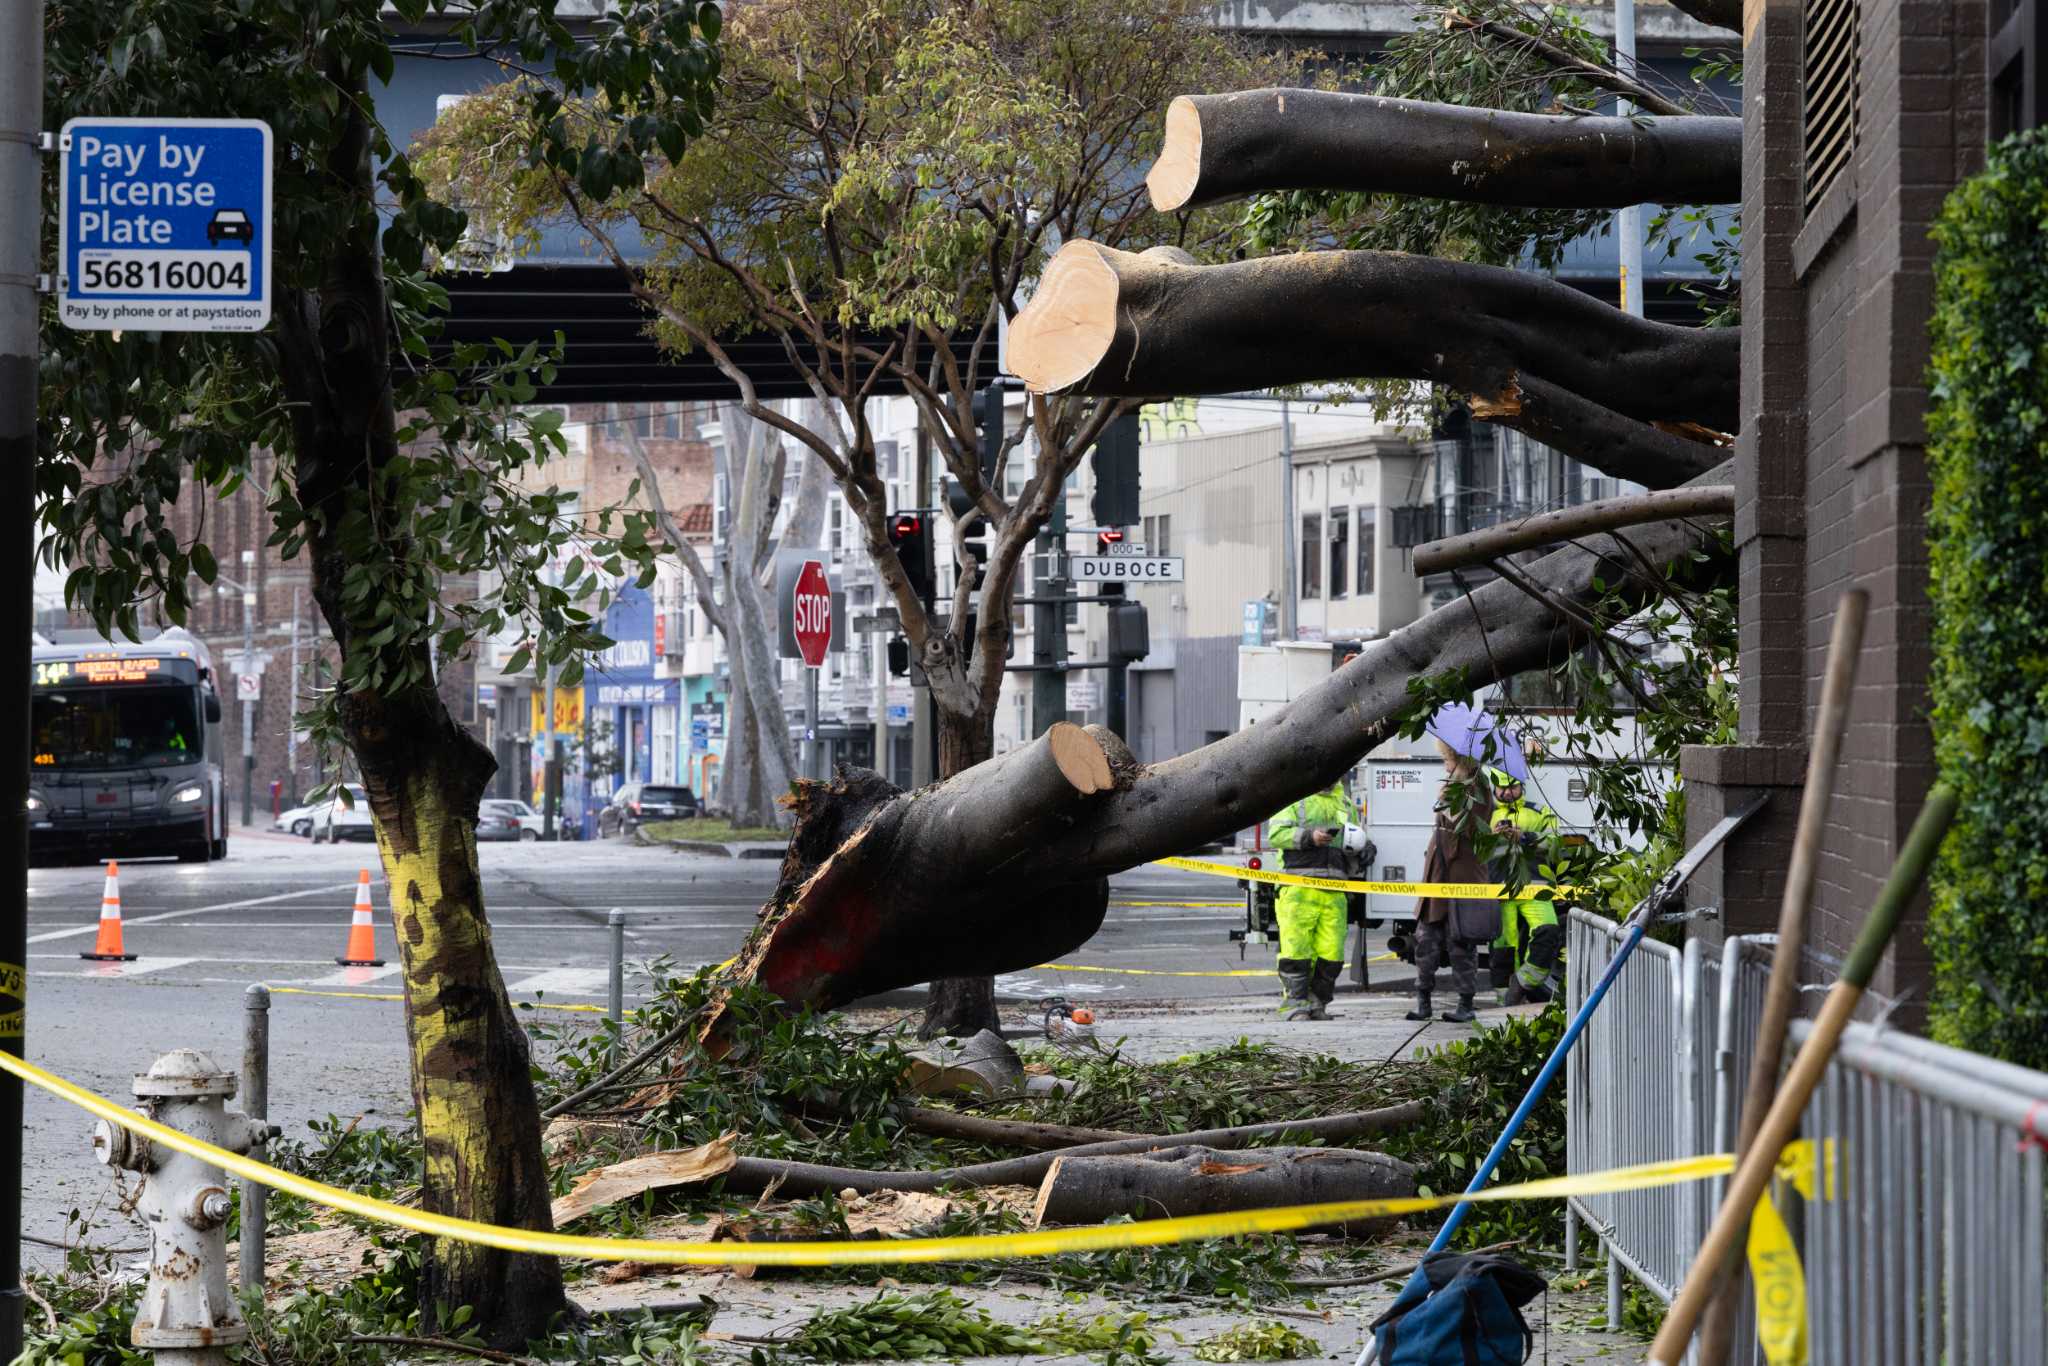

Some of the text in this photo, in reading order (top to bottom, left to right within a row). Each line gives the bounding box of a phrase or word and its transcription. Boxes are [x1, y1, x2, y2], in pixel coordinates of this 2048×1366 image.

[79, 135, 205, 178] Pay by
[79, 173, 216, 207] License
[78, 210, 173, 244] Plate
[84, 260, 248, 290] 56816004
[66, 304, 262, 320] Pay by phone or at paystation
[1083, 562, 1171, 577] DUBOCE
[796, 593, 830, 634] STOP
[1381, 774, 1405, 789] 9-1-1
